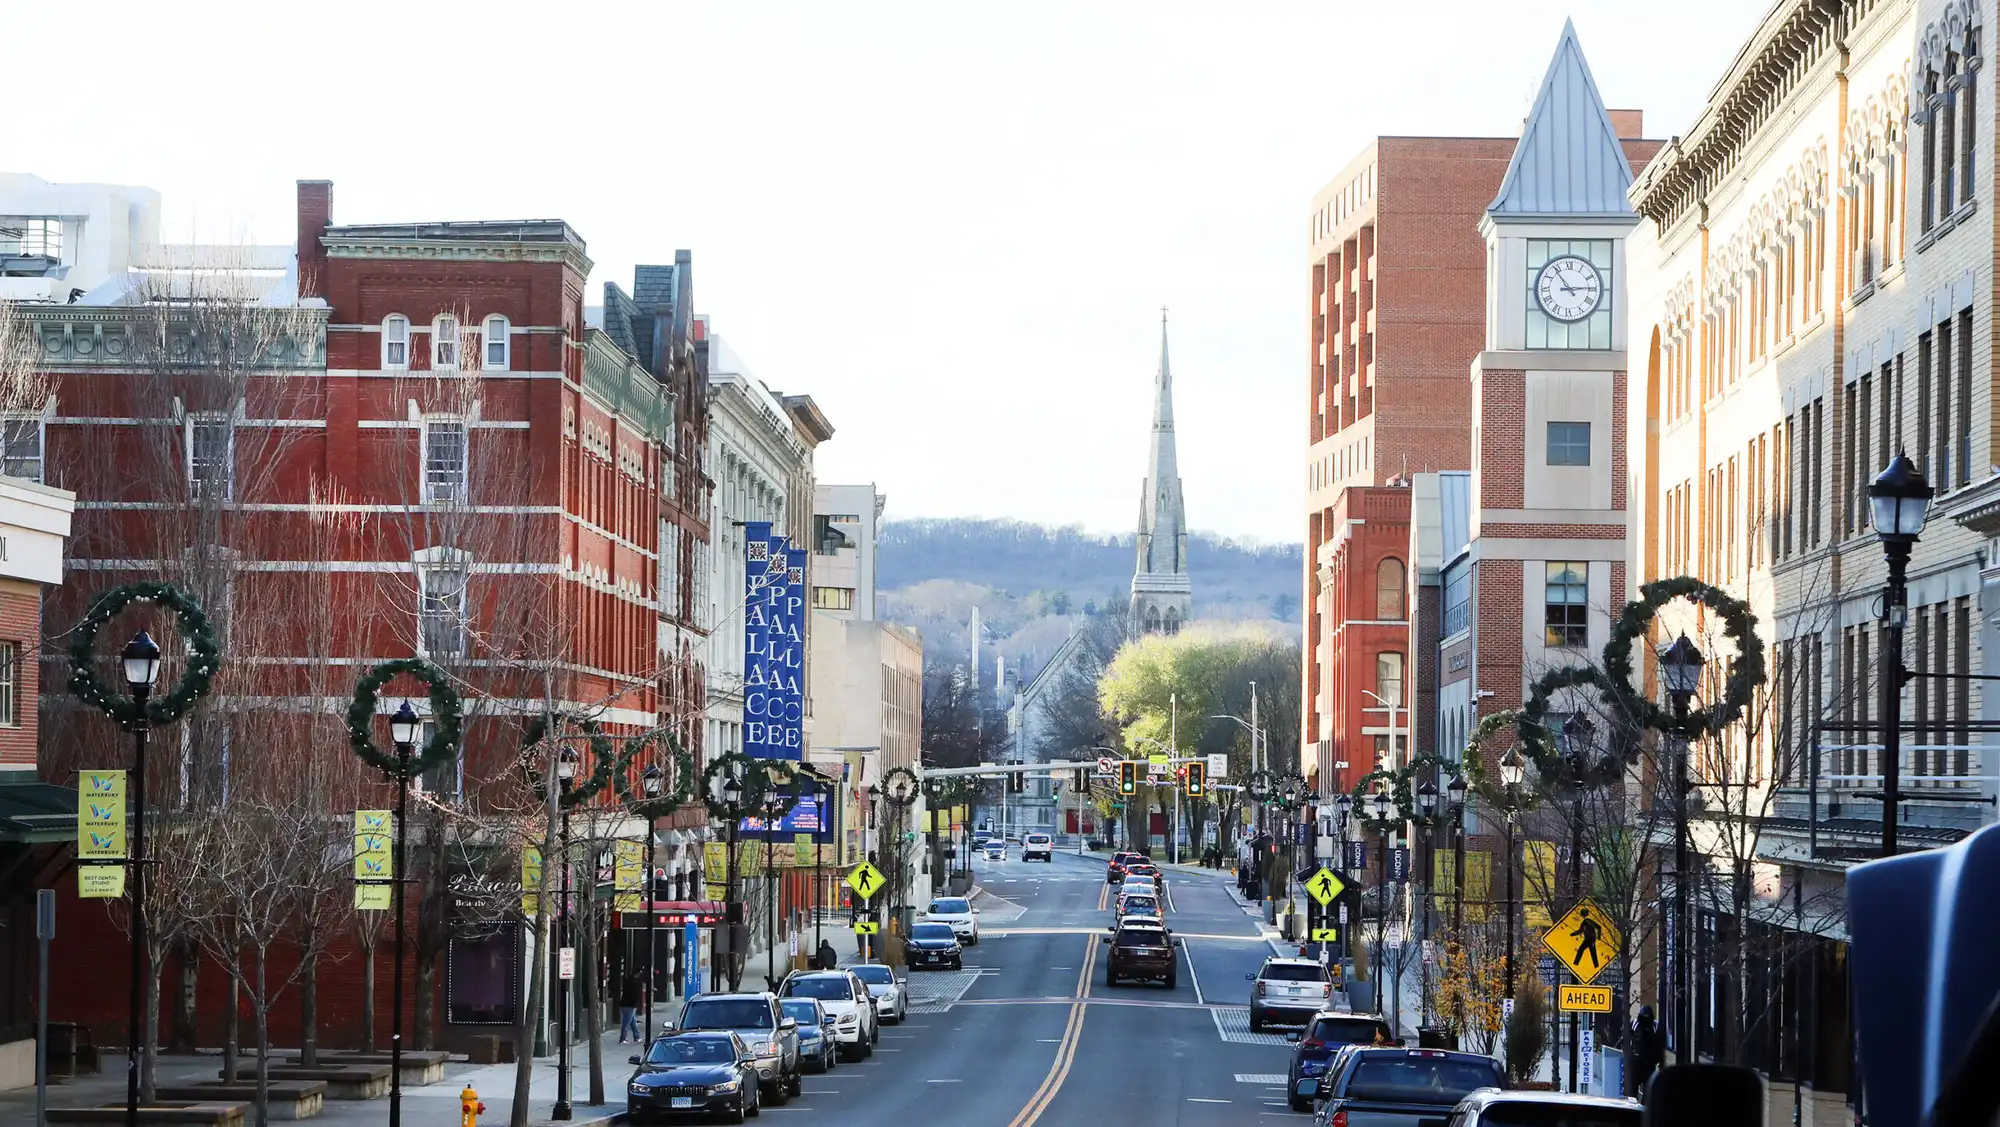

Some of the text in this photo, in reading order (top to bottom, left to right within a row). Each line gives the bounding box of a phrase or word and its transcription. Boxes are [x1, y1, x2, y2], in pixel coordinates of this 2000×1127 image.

[746, 574, 768, 745] PALACE
[767, 586, 786, 746] PALACE
[785, 597, 802, 749] PALACE
[1566, 992, 1605, 1005] AHEAD
